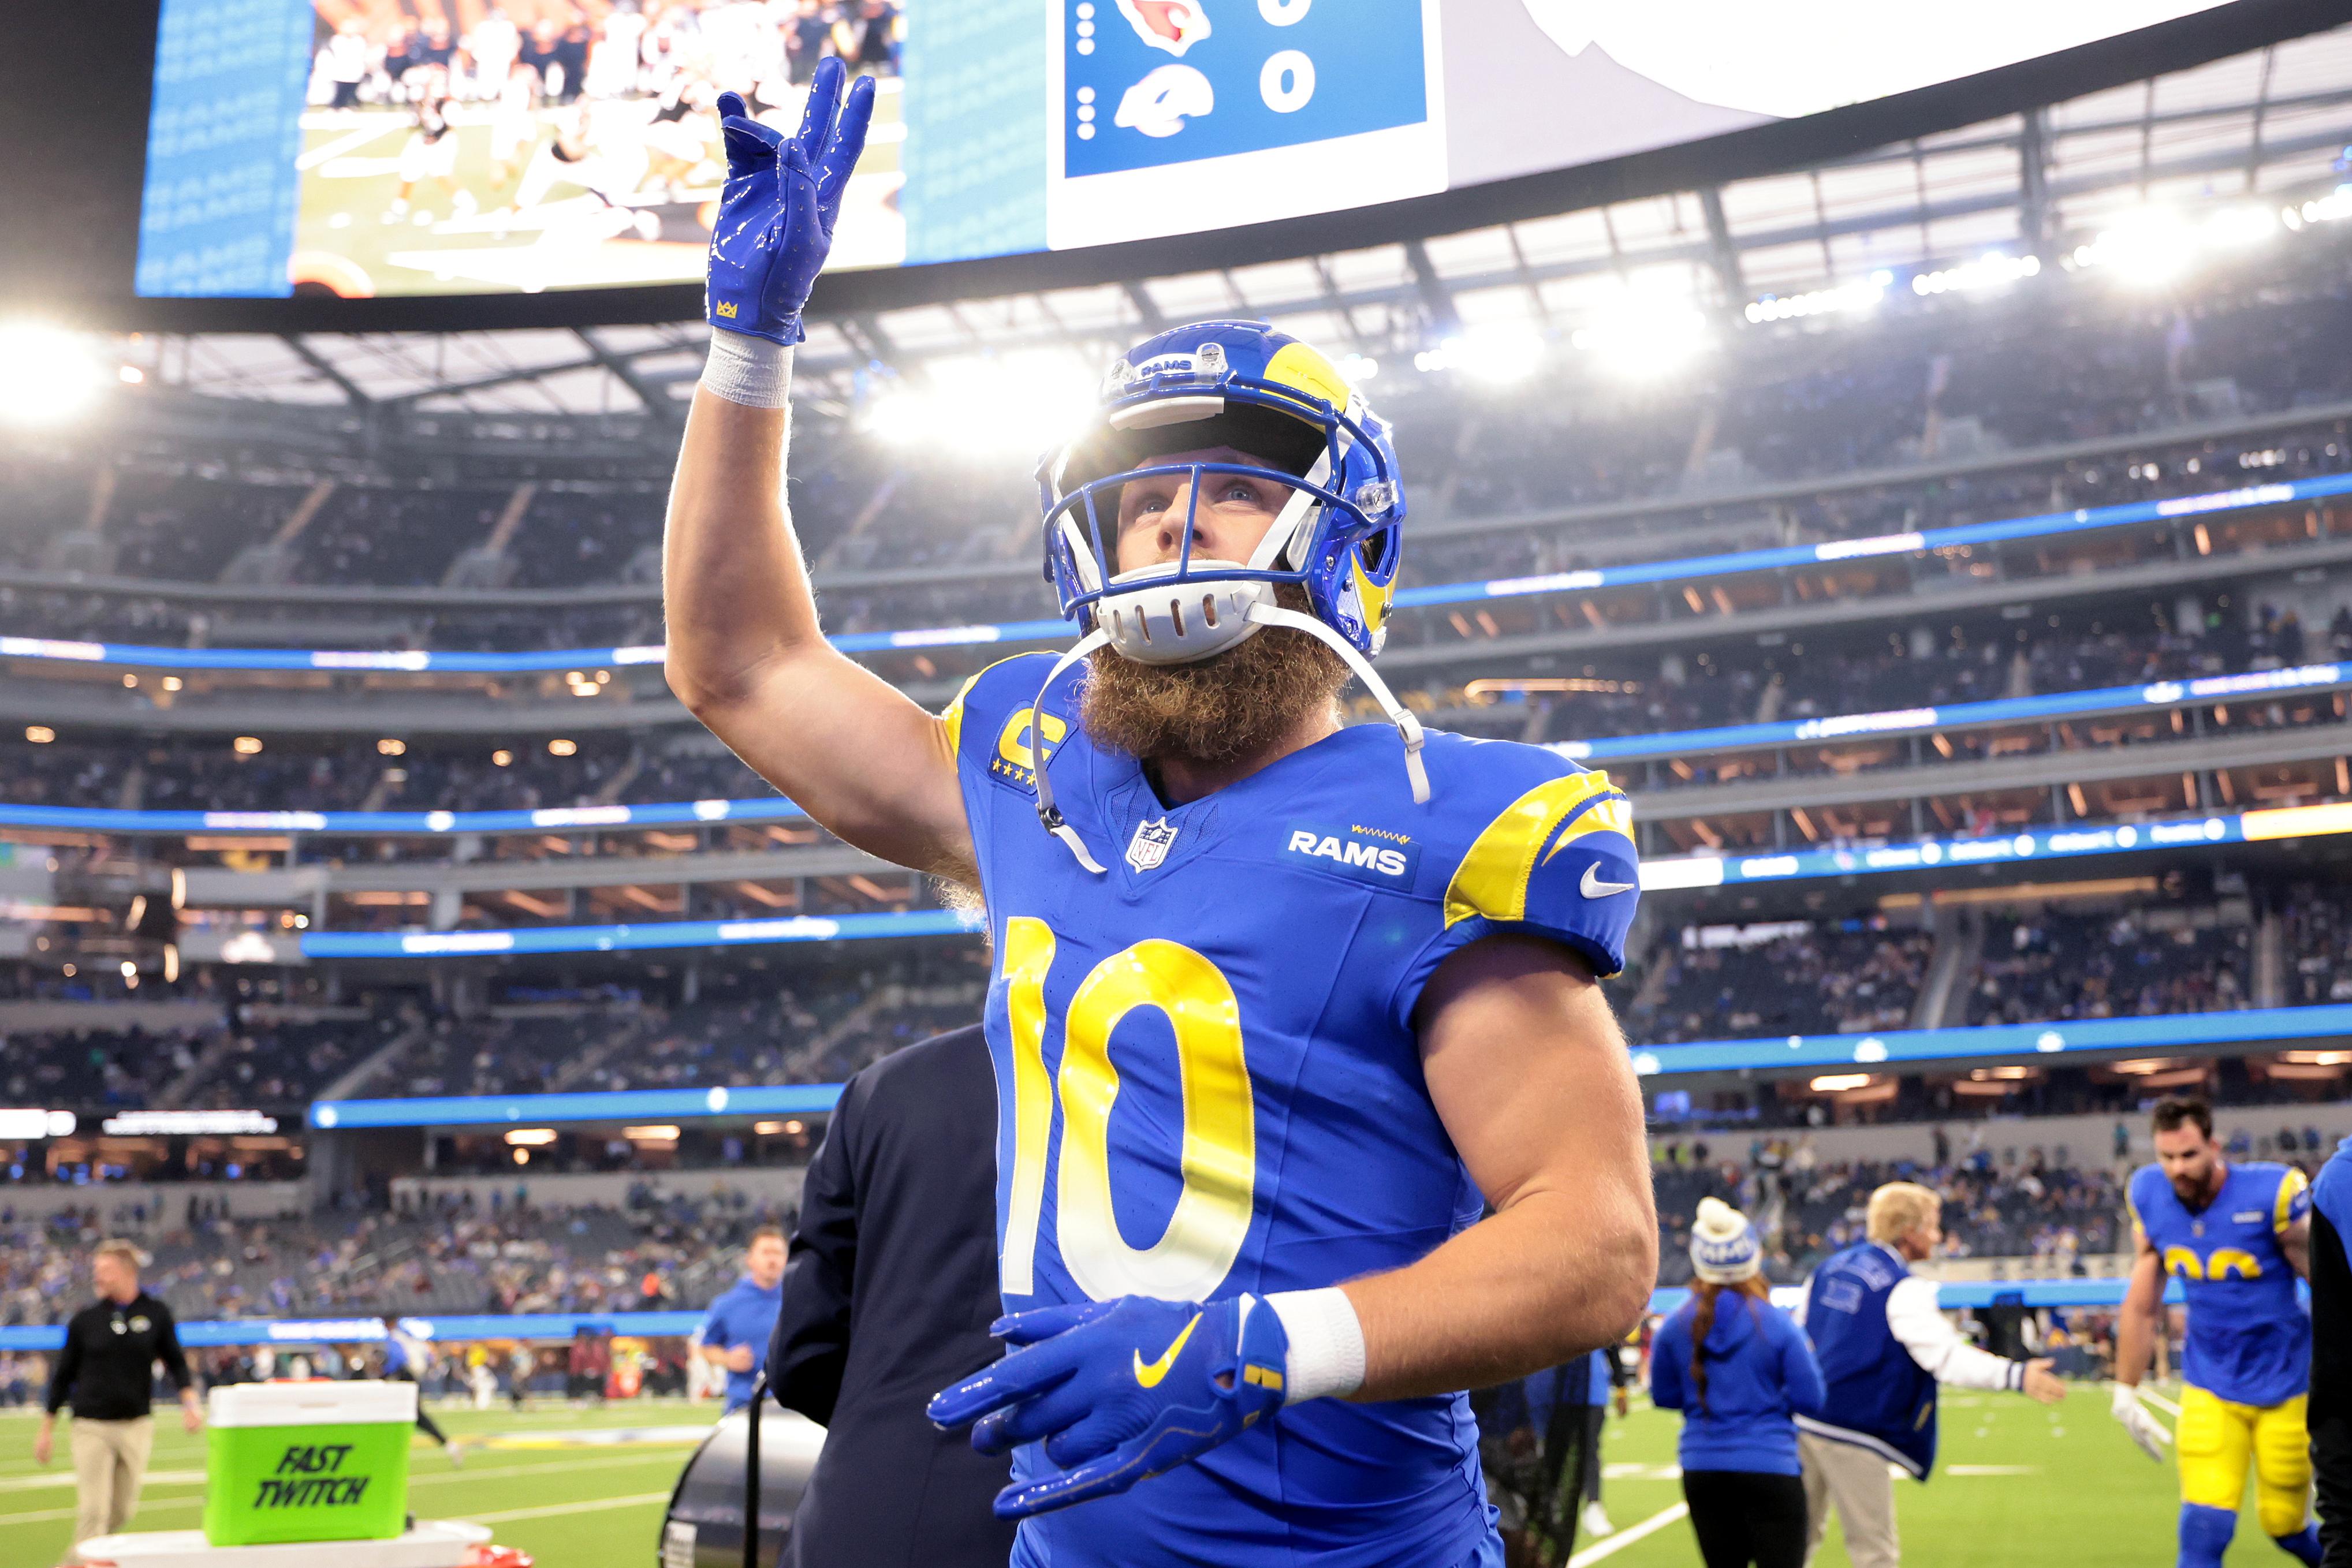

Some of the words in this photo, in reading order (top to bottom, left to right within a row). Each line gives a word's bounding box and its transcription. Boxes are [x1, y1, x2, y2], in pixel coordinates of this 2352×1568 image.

[1259, 50, 1316, 113] 0
[1140, 360, 1192, 378] RAMS
[998, 708, 1067, 770] C
[1133, 840, 1160, 862] NFL
[1288, 830, 1407, 876] RAMS
[1001, 916, 1255, 1302] 10
[276, 1444, 354, 1474] FAST
[253, 1476, 371, 1508] TWITCH
